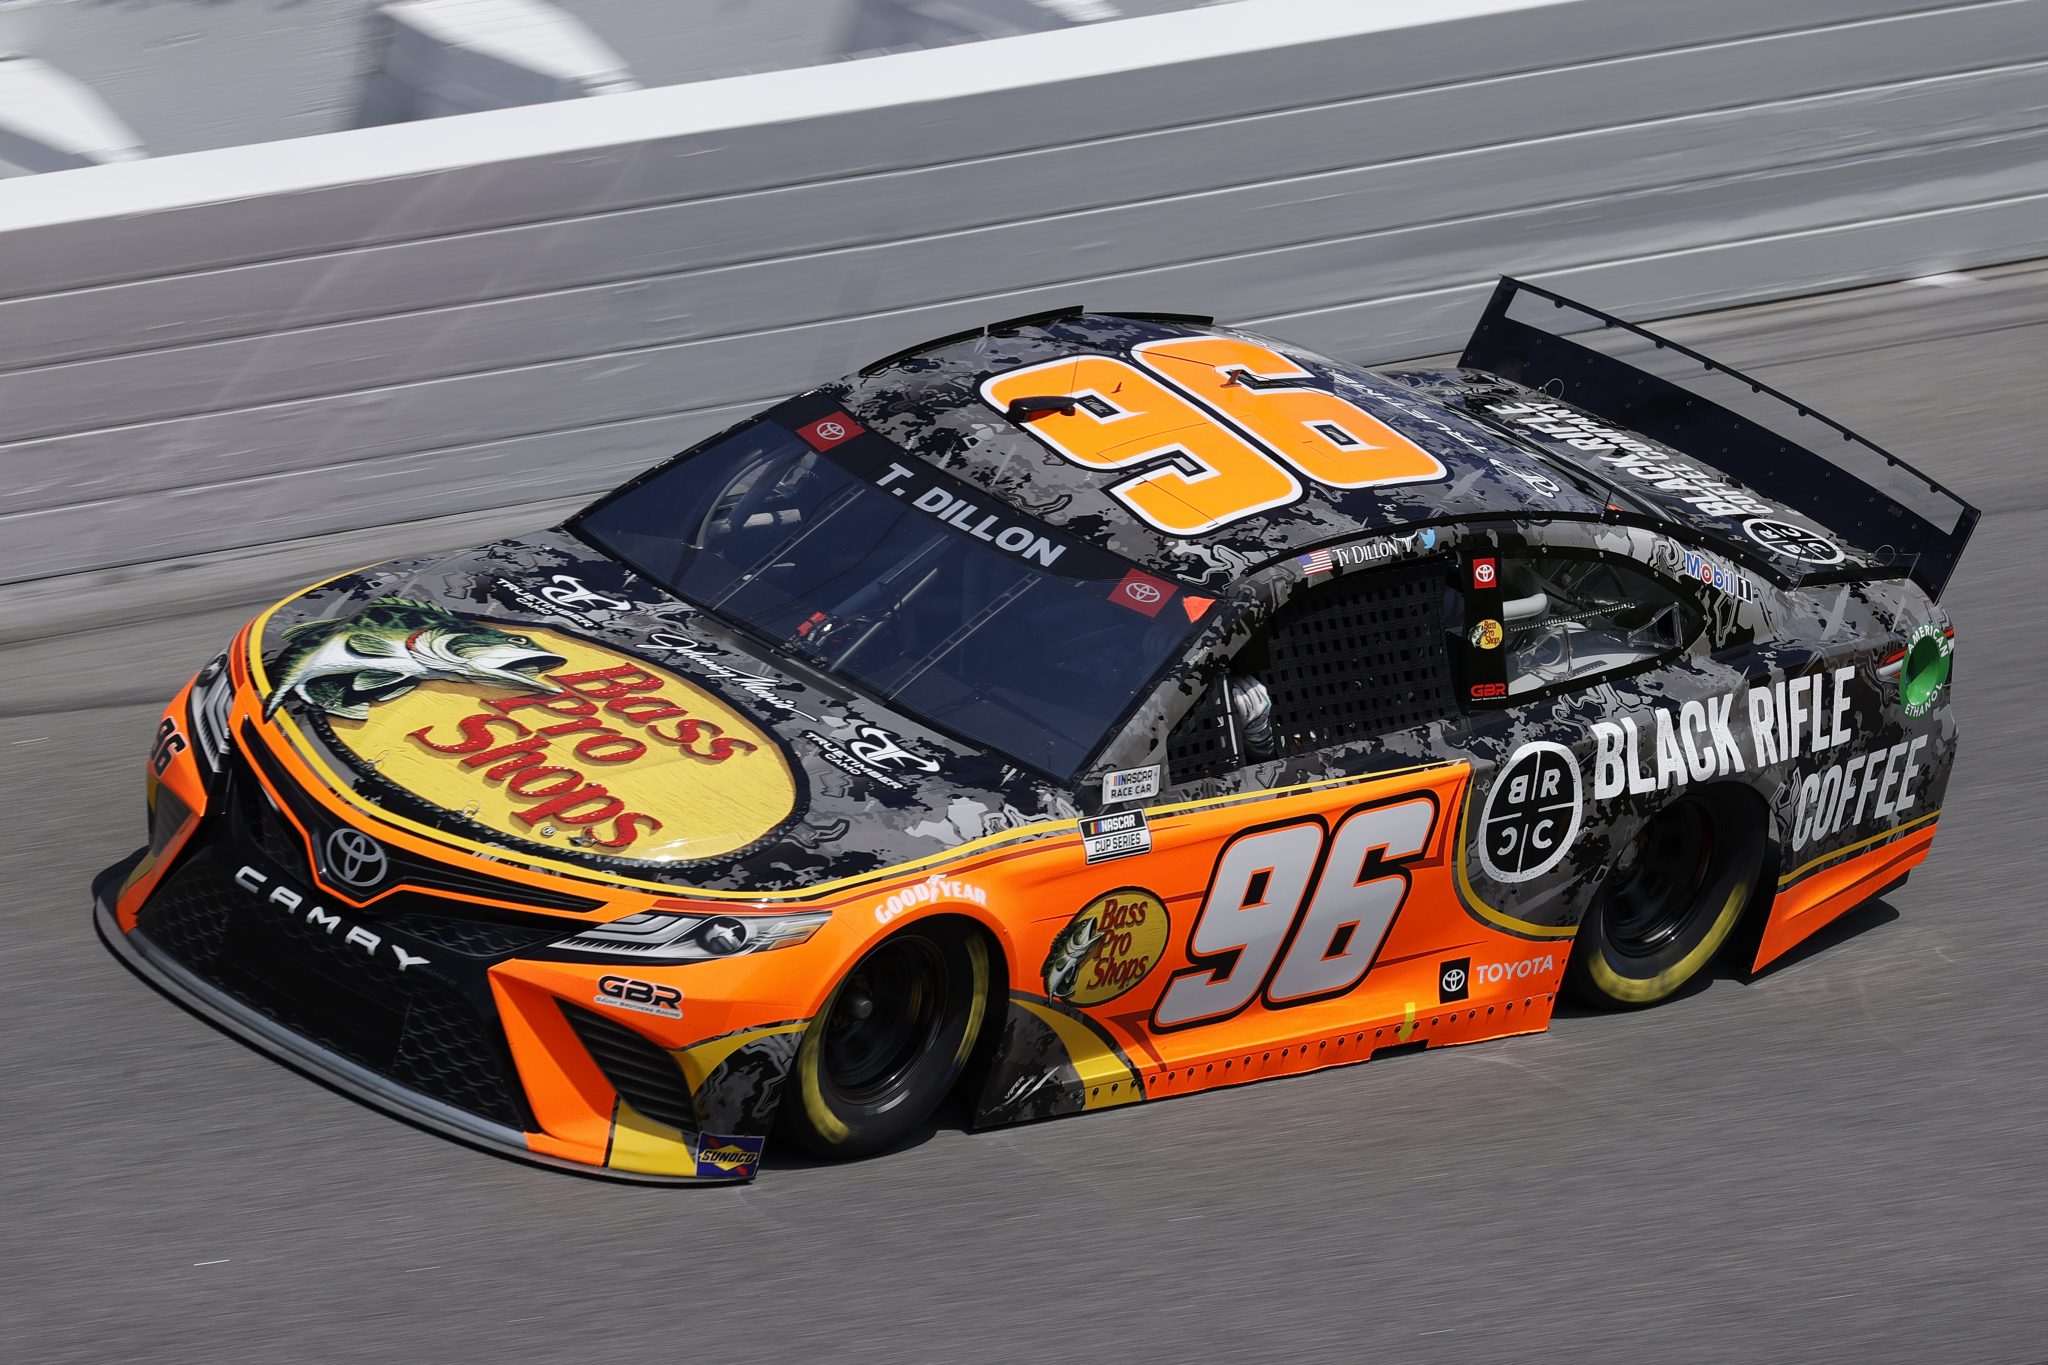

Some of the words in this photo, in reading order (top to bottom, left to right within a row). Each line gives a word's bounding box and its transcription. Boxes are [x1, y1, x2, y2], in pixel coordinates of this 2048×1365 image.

[979, 335, 1447, 536] 96
[1484, 402, 1617, 451] RIFLE
[1526, 402, 1670, 460] COMPANY
[1598, 453, 1747, 517] BLACK
[1659, 463, 1774, 514] COFFEE
[875, 462, 915, 496] T.
[912, 487, 1067, 568] DILLON
[1351, 538, 1399, 564] DILLON
[1685, 550, 1735, 596] Mobil
[497, 578, 595, 628] TRUETIMBER
[515, 597, 553, 616] CAMO
[1907, 624, 1949, 658] AMERICAN
[543, 661, 758, 763] Bass
[1470, 683, 1506, 697] GBR
[1904, 682, 1943, 718] ETHANOL
[481, 690, 648, 763] Pro
[1591, 690, 1747, 800] BLACK
[1748, 666, 1857, 768] RIFLE
[406, 712, 662, 848] Shops
[805, 731, 905, 790] TRUETIMBER
[825, 753, 862, 776] CAMO
[1120, 769, 1153, 787] NASCAR
[1111, 785, 1133, 799] RACE
[1135, 783, 1152, 796] CAR
[1791, 735, 1928, 852] COFFEE
[1095, 837, 1114, 854] CUP
[1114, 832, 1141, 849] SERIES
[1100, 813, 1137, 833] NASCAR
[234, 865, 432, 972] CAMRY
[874, 876, 987, 925] GOODYEAR
[1099, 898, 1149, 931] Bass
[1153, 793, 1439, 1030] 96
[1098, 930, 1133, 957] Pro
[598, 975, 683, 1010] GBR
[1086, 955, 1149, 991] Shops
[1476, 954, 1555, 985] TOYOTA
[701, 1149, 759, 1165] SUNOCO
